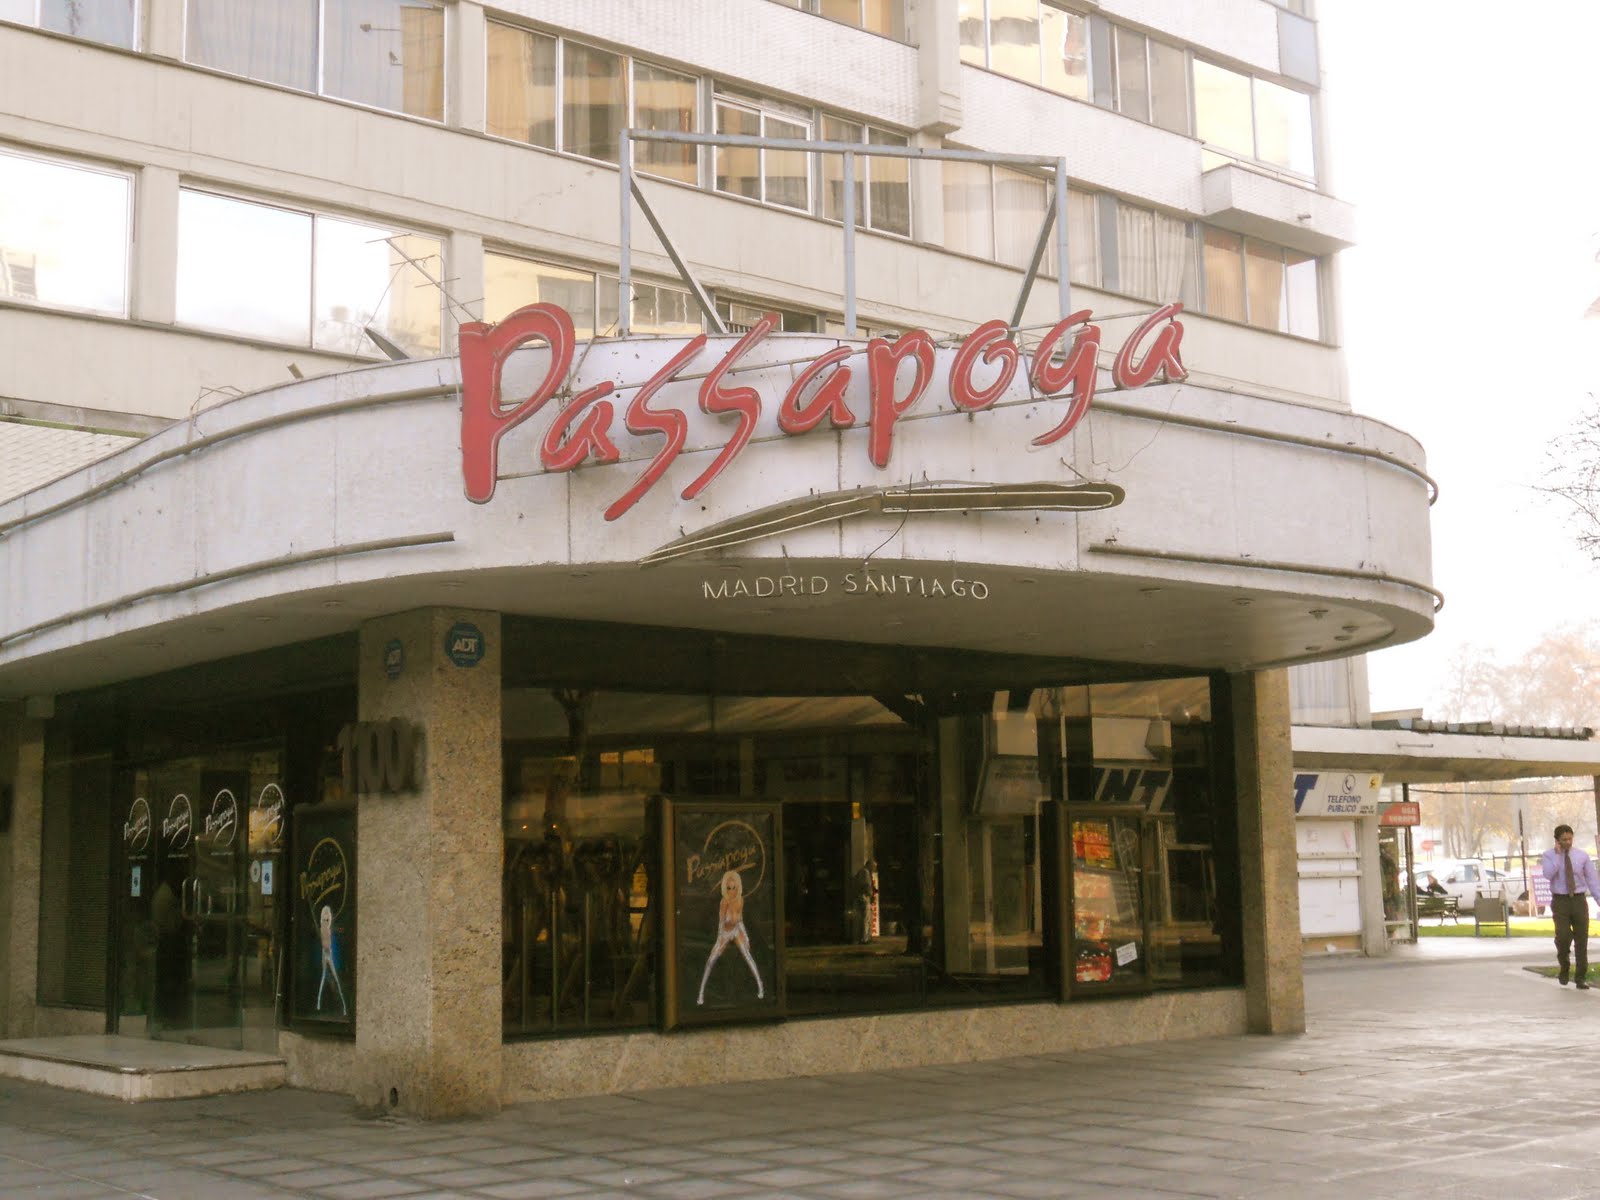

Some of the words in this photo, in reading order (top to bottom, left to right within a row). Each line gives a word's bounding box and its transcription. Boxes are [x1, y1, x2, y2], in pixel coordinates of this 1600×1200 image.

[702, 575, 829, 599] MADRID
[843, 573, 989, 600] SANTIAGO
[452, 638, 479, 653] ADT
[1327, 795, 1362, 804] TELEFONO
